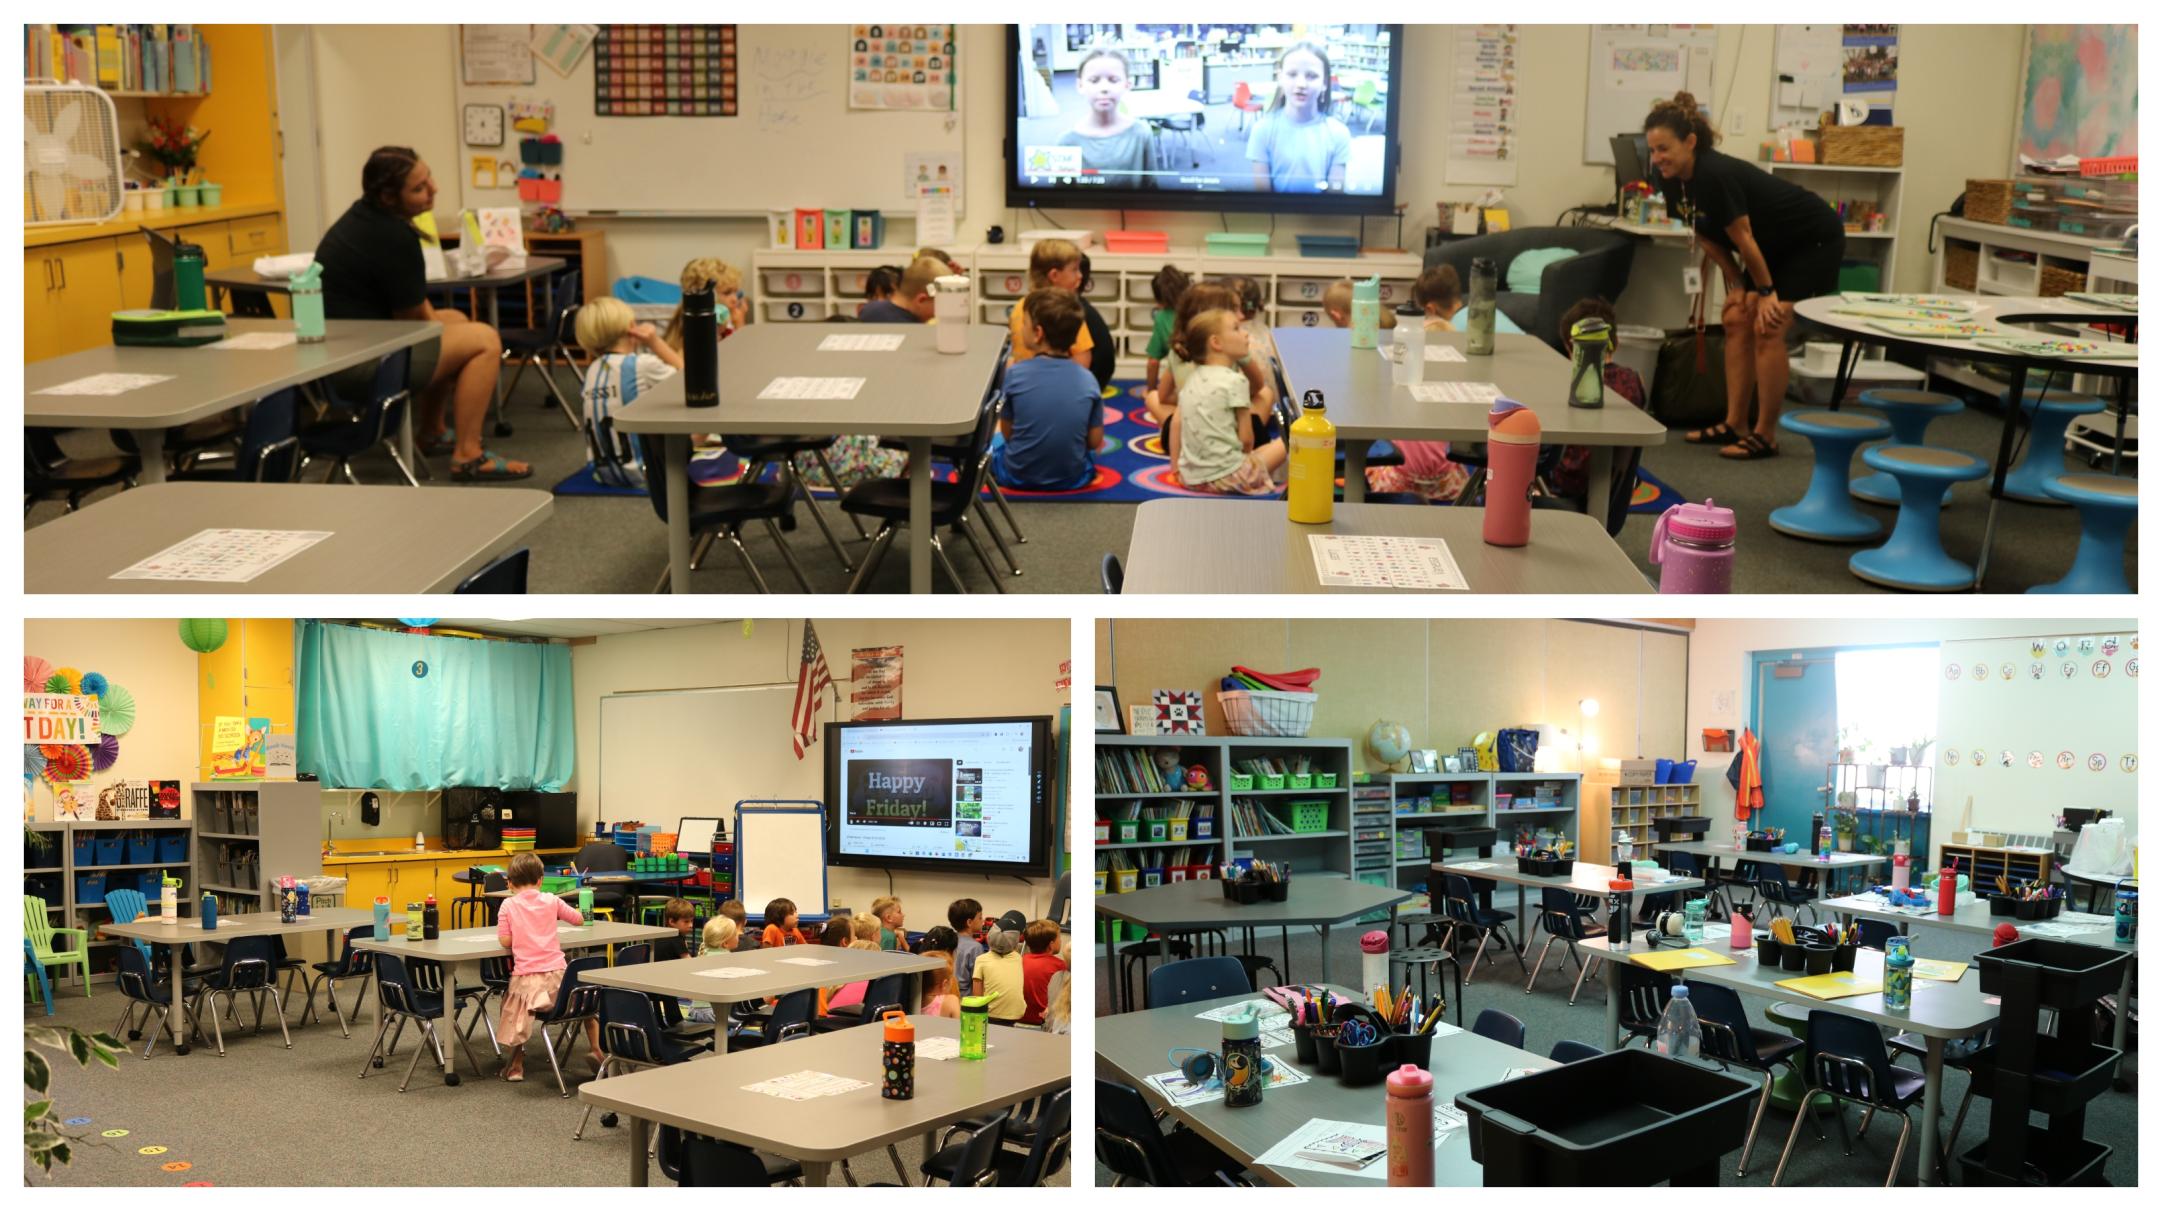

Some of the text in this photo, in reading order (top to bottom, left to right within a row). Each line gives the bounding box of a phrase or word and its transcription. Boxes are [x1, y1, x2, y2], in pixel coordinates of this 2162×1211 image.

[44, 698, 64, 710] FOR
[66, 699, 72, 710] A
[38, 716, 86, 740] DAY!
[868, 772, 926, 795] Happy
[866, 799, 928, 819] Friday!
